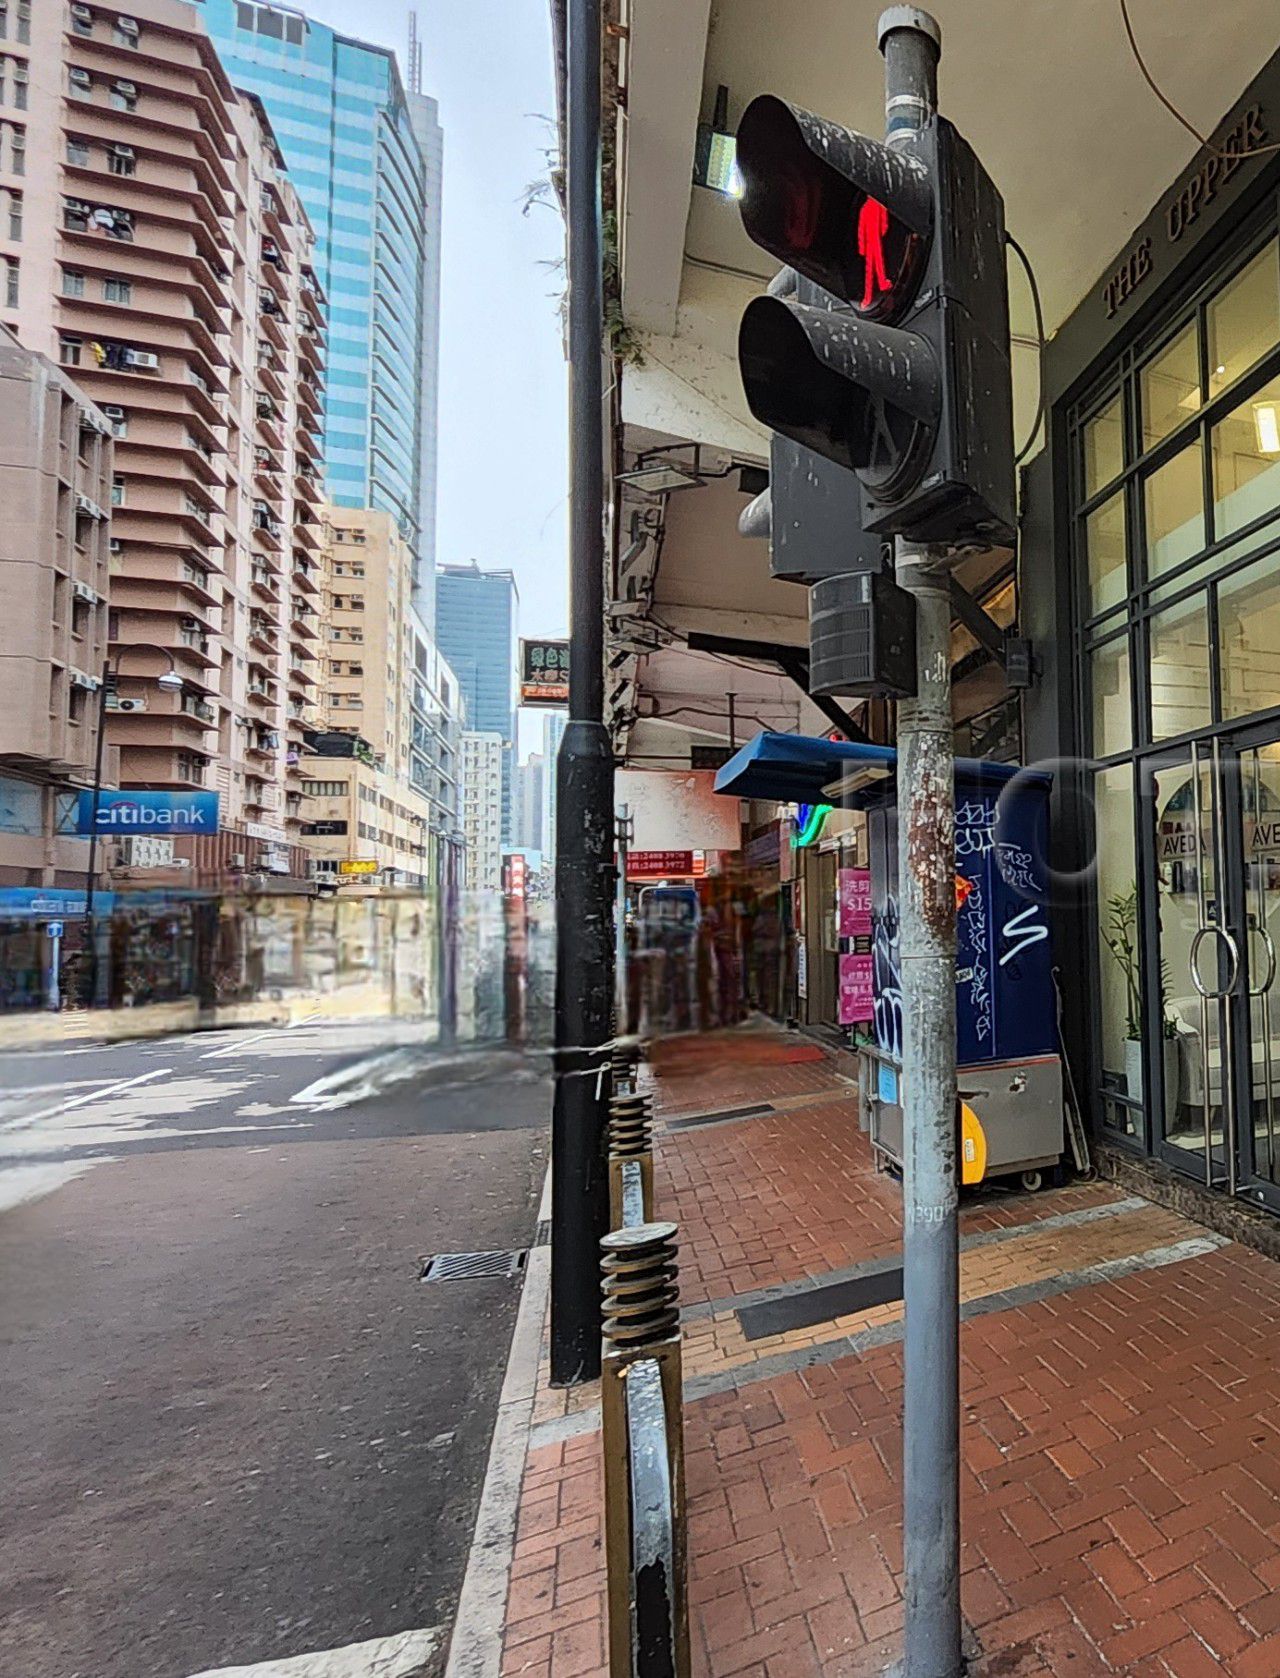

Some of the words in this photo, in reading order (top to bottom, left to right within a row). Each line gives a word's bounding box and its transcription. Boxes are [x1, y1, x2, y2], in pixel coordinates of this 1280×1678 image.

[1101, 236, 1154, 320] THE
[1165, 103, 1268, 243] UPPER
[95, 801, 205, 826] citibank
